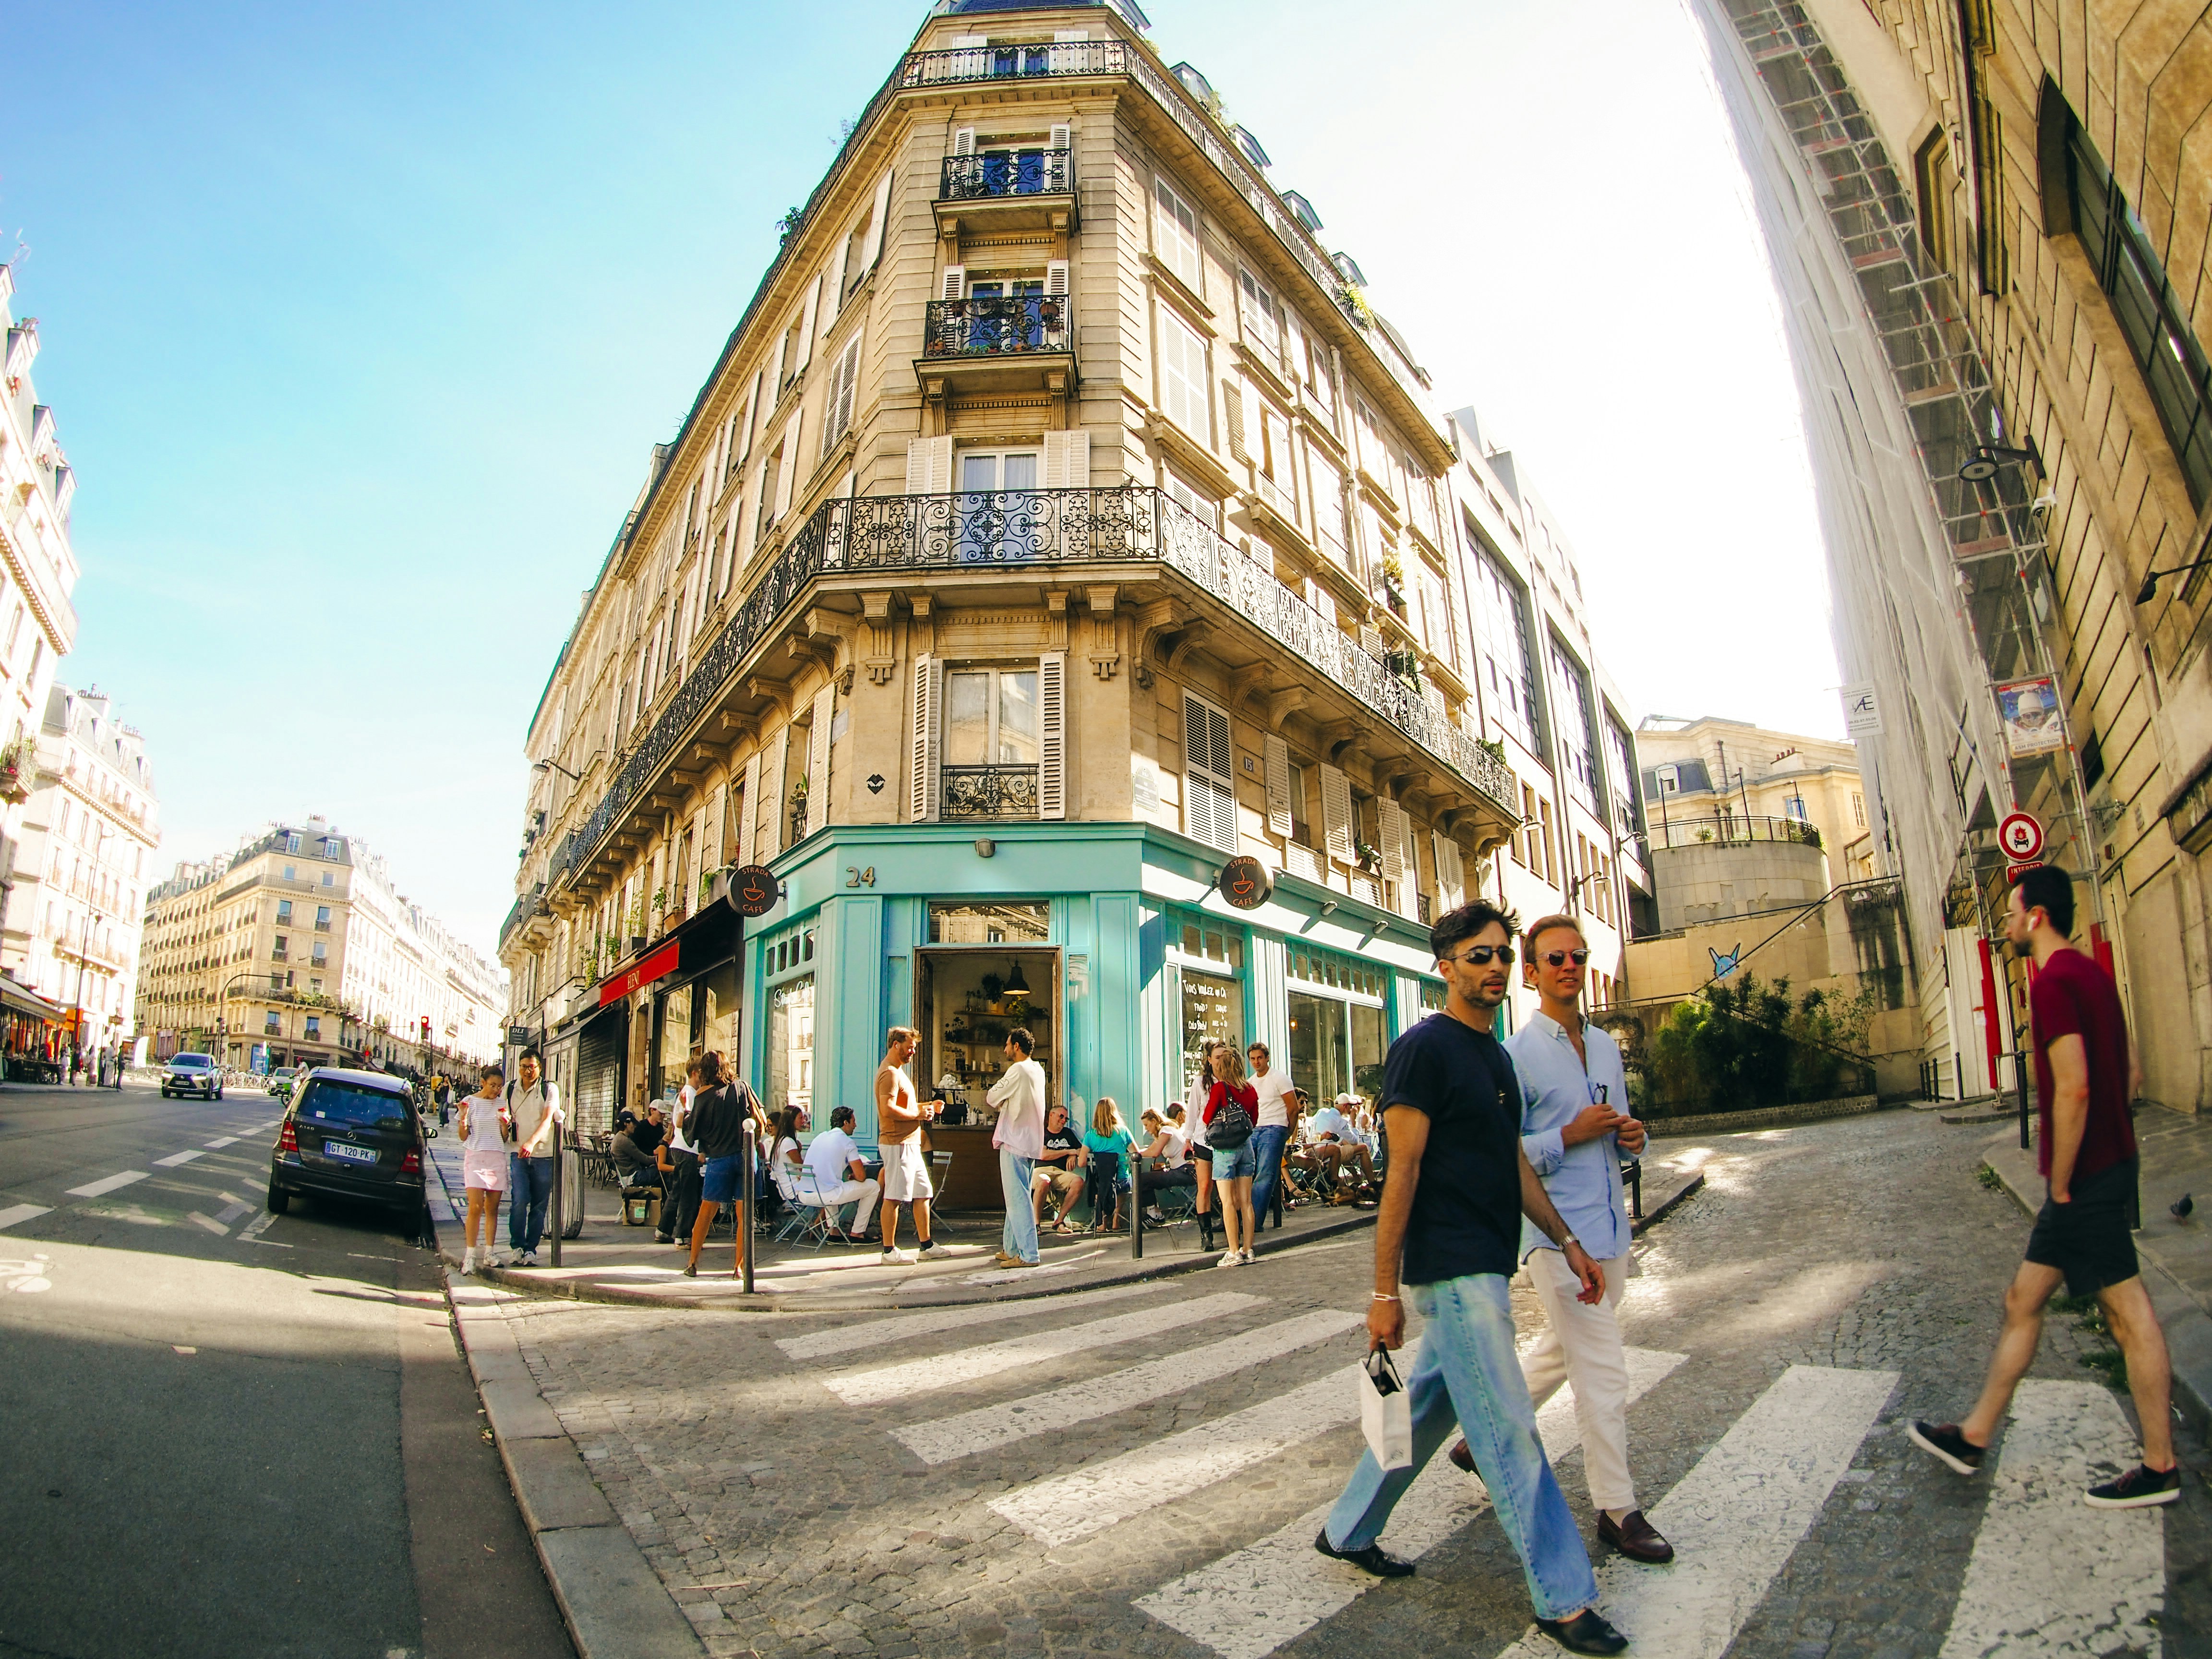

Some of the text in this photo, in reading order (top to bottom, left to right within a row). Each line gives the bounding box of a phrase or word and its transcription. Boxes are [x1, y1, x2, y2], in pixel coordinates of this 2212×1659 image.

[2027, 738, 2059, 748] PROTECTION
[1245, 758, 1252, 771] 15
[1230, 858, 1256, 869] STRADA
[742, 867, 769, 878] STRADA
[846, 866, 876, 887] 24
[1232, 896, 1253, 906] CAFE
[743, 904, 764, 913] CAFE
[627, 970, 639, 989] ELENI
[1188, 1020, 1197, 1030] COLD
